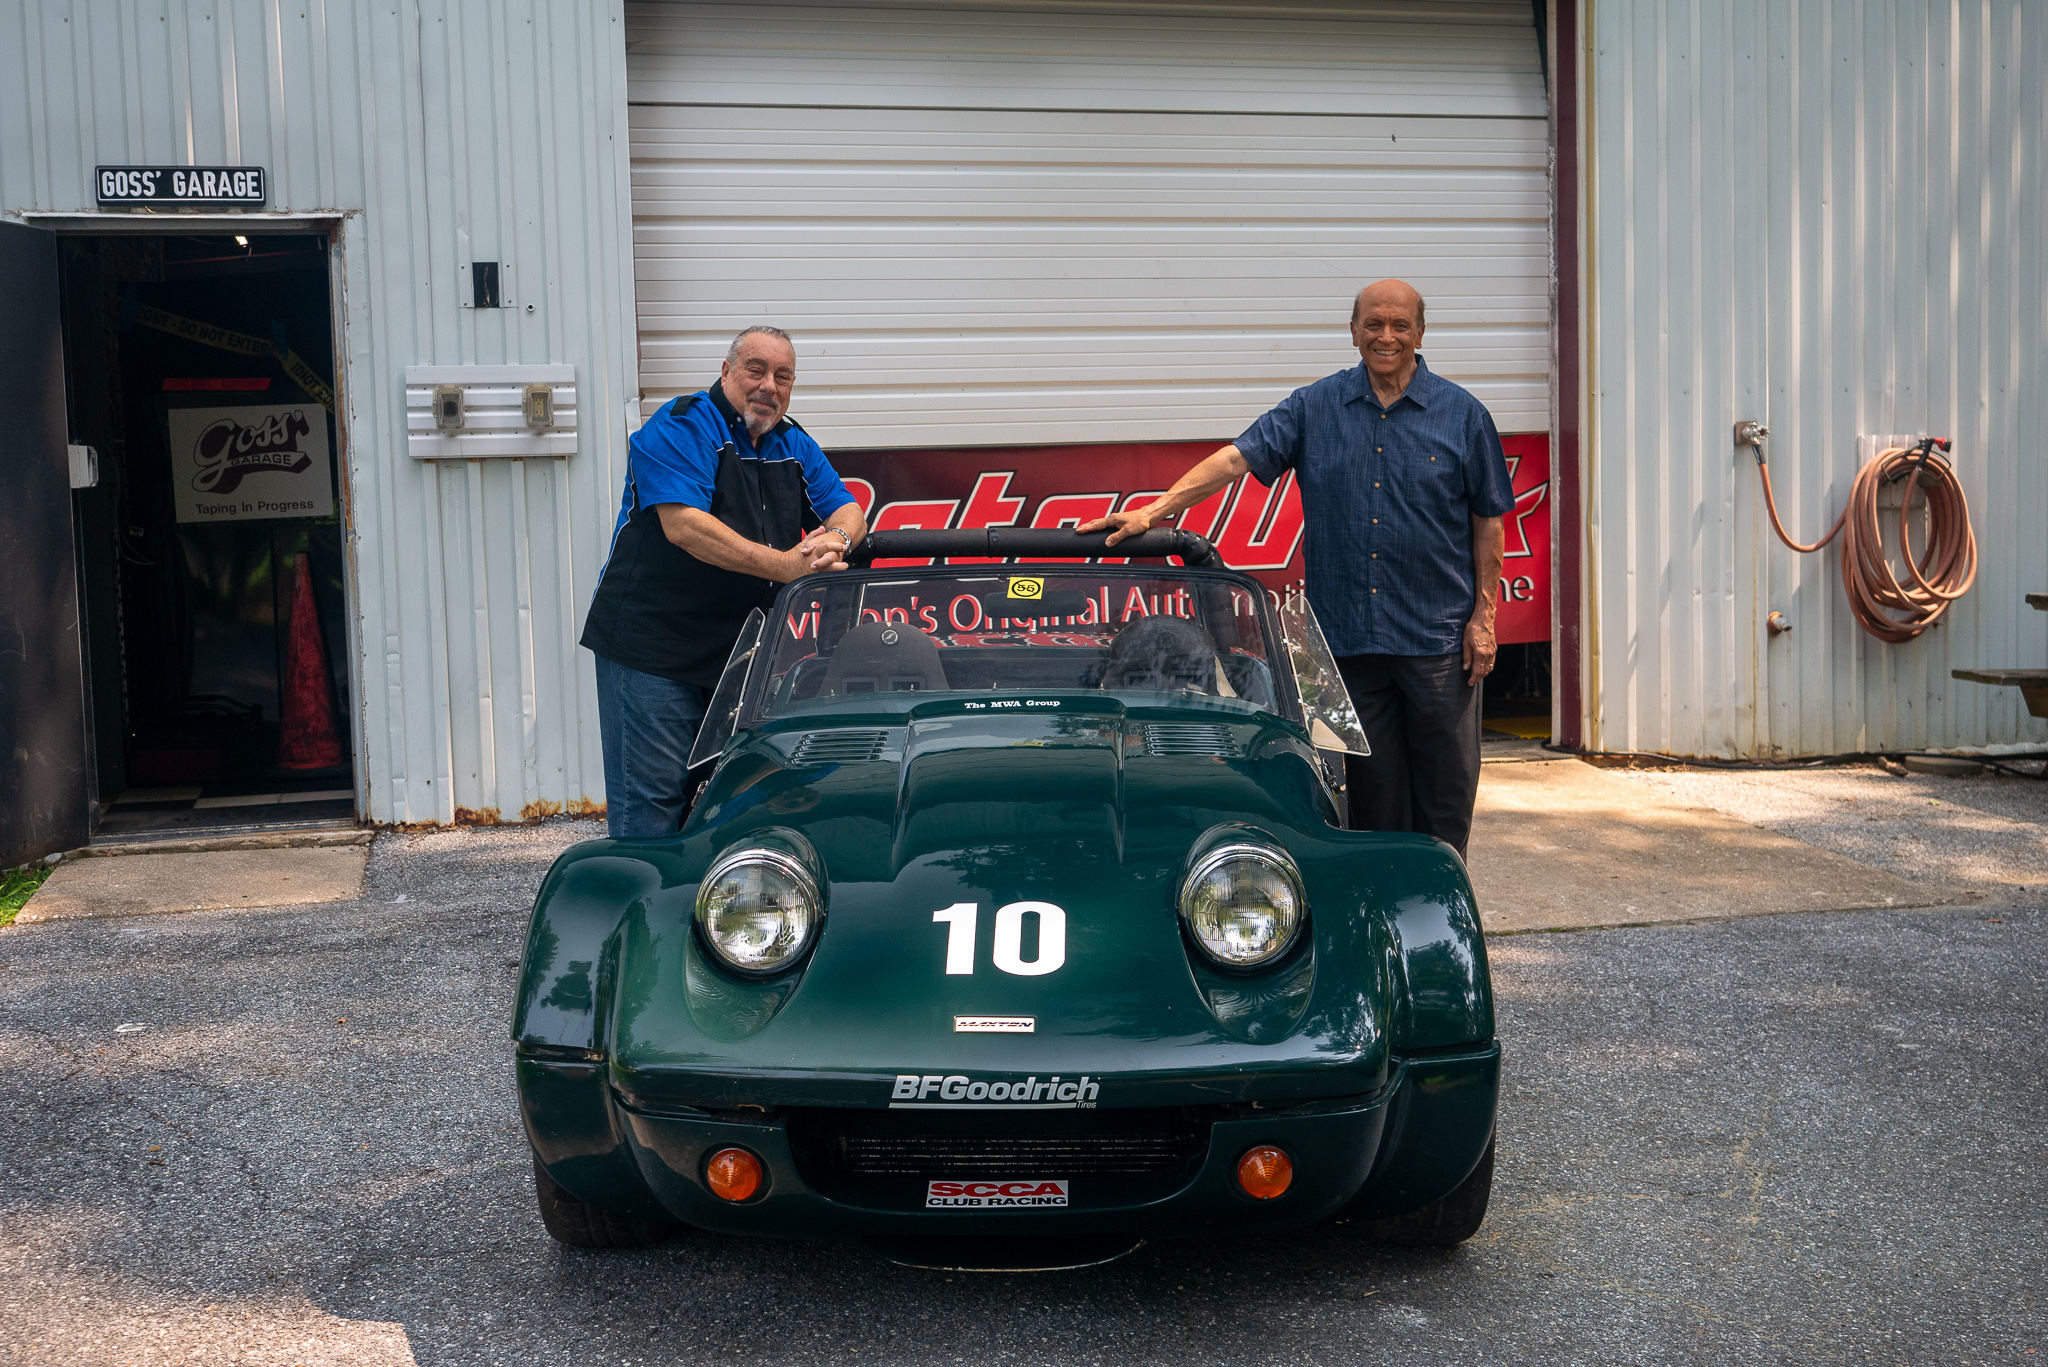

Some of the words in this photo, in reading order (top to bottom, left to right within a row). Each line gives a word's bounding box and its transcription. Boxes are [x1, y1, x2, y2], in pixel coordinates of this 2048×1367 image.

[102, 171, 161, 197] GOSS'
[173, 171, 260, 197] GARAGE
[179, 320, 197, 335] DO
[199, 326, 225, 344] NOT
[290, 362, 321, 391] IDIOT
[230, 453, 292, 466] GARAGE
[195, 503, 237, 516] Taping
[242, 502, 253, 512] In
[258, 501, 314, 513] Progress
[990, 700, 1022, 708] MWA
[1026, 699, 1061, 707] Group
[932, 901, 1066, 976] 10
[891, 1075, 1100, 1100] BFGoodrich
[1076, 1101, 1097, 1109] Tires
[929, 1182, 1066, 1197] SCCA
[927, 1197, 984, 1206] CLUB
[987, 1197, 1067, 1206] RACING
